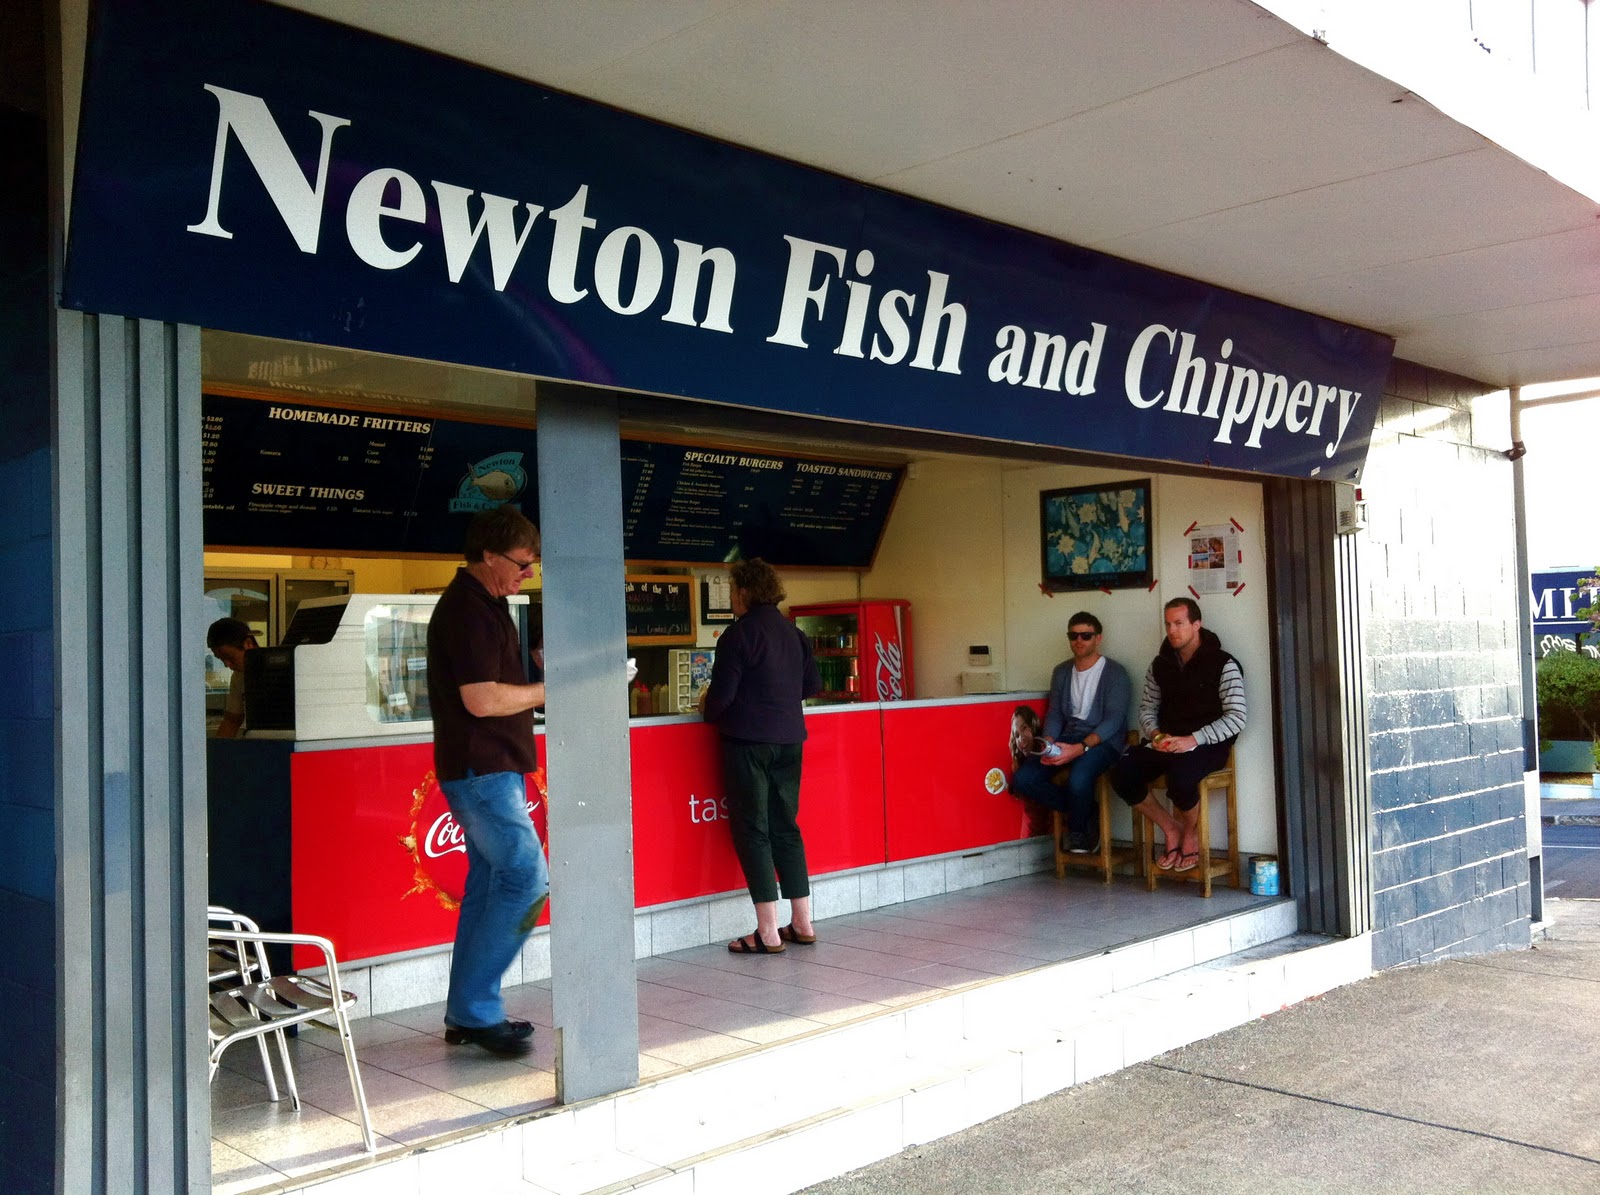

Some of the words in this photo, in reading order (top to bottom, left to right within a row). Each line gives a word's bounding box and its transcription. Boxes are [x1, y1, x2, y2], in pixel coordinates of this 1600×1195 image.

[187, 83, 738, 334] Newton
[766, 234, 968, 376] Fish
[987, 323, 1108, 398] and
[1124, 323, 1364, 459] Chippery
[268, 407, 359, 427] HOMEMADE
[362, 416, 431, 434] FRITTERS
[479, 458, 515, 470] Newton
[683, 451, 738, 465] SPECIALTY
[738, 457, 784, 470] BURGERS
[796, 463, 836, 476] TOASTED
[836, 467, 893, 481] SANDWICHES
[251, 483, 305, 497] SWEET
[309, 487, 365, 501] THINGS
[625, 582, 635, 592] ish
[640, 582, 648, 592] of
[652, 584, 662, 594] the
[668, 584, 679, 595] Day
[688, 794, 729, 824] tas
